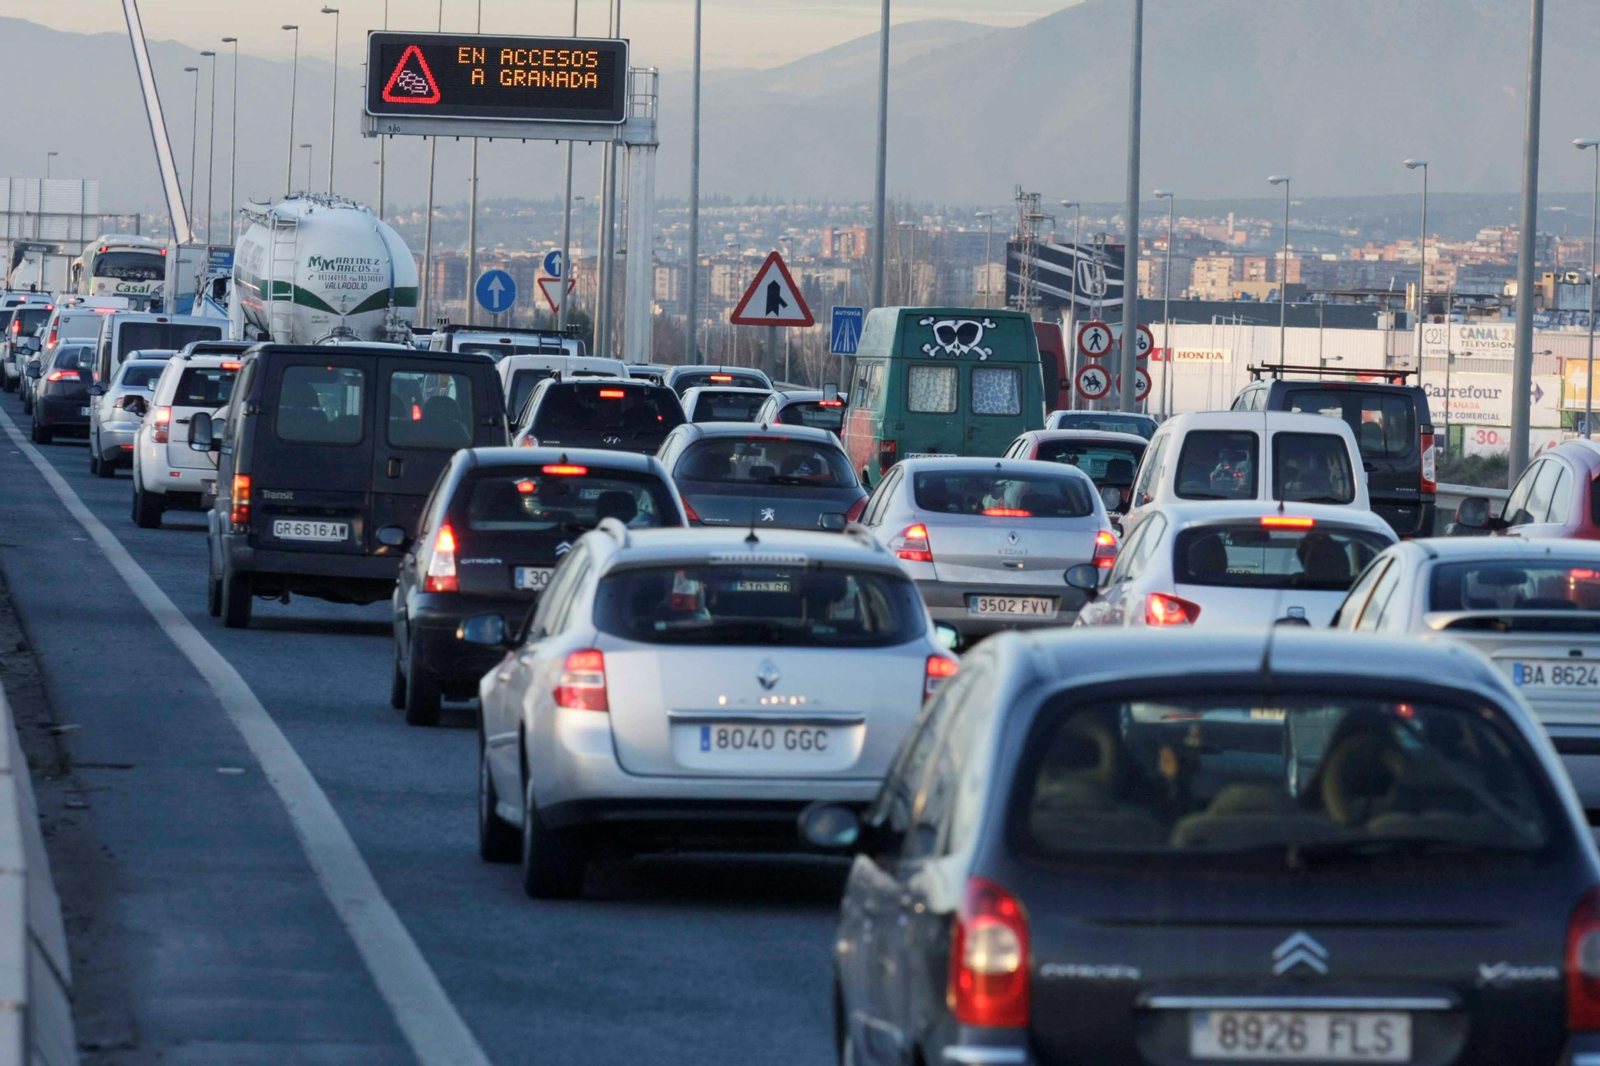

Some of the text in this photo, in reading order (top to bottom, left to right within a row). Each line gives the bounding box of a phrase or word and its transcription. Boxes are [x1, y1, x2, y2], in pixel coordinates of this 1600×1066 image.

[458, 47, 599, 68] EN ACCESOS
[471, 68, 598, 89] A GRANADA
[115, 282, 151, 294] Casal
[325, 282, 368, 290] VALLADOLID
[1459, 326, 1499, 340] CANAL
[1460, 340, 1516, 349] TELEVISION
[1177, 351, 1224, 360] HONDA
[1423, 382, 1502, 399] Carrefour
[1455, 411, 1500, 420] COMERCIAL
[262, 490, 294, 500] Transit
[980, 599, 1048, 614] 3502 FVV
[1523, 665, 1599, 686] BA 8624
[716, 728, 827, 751] 8040 GGC
[1217, 1014, 1393, 1054] 8926 FLS
